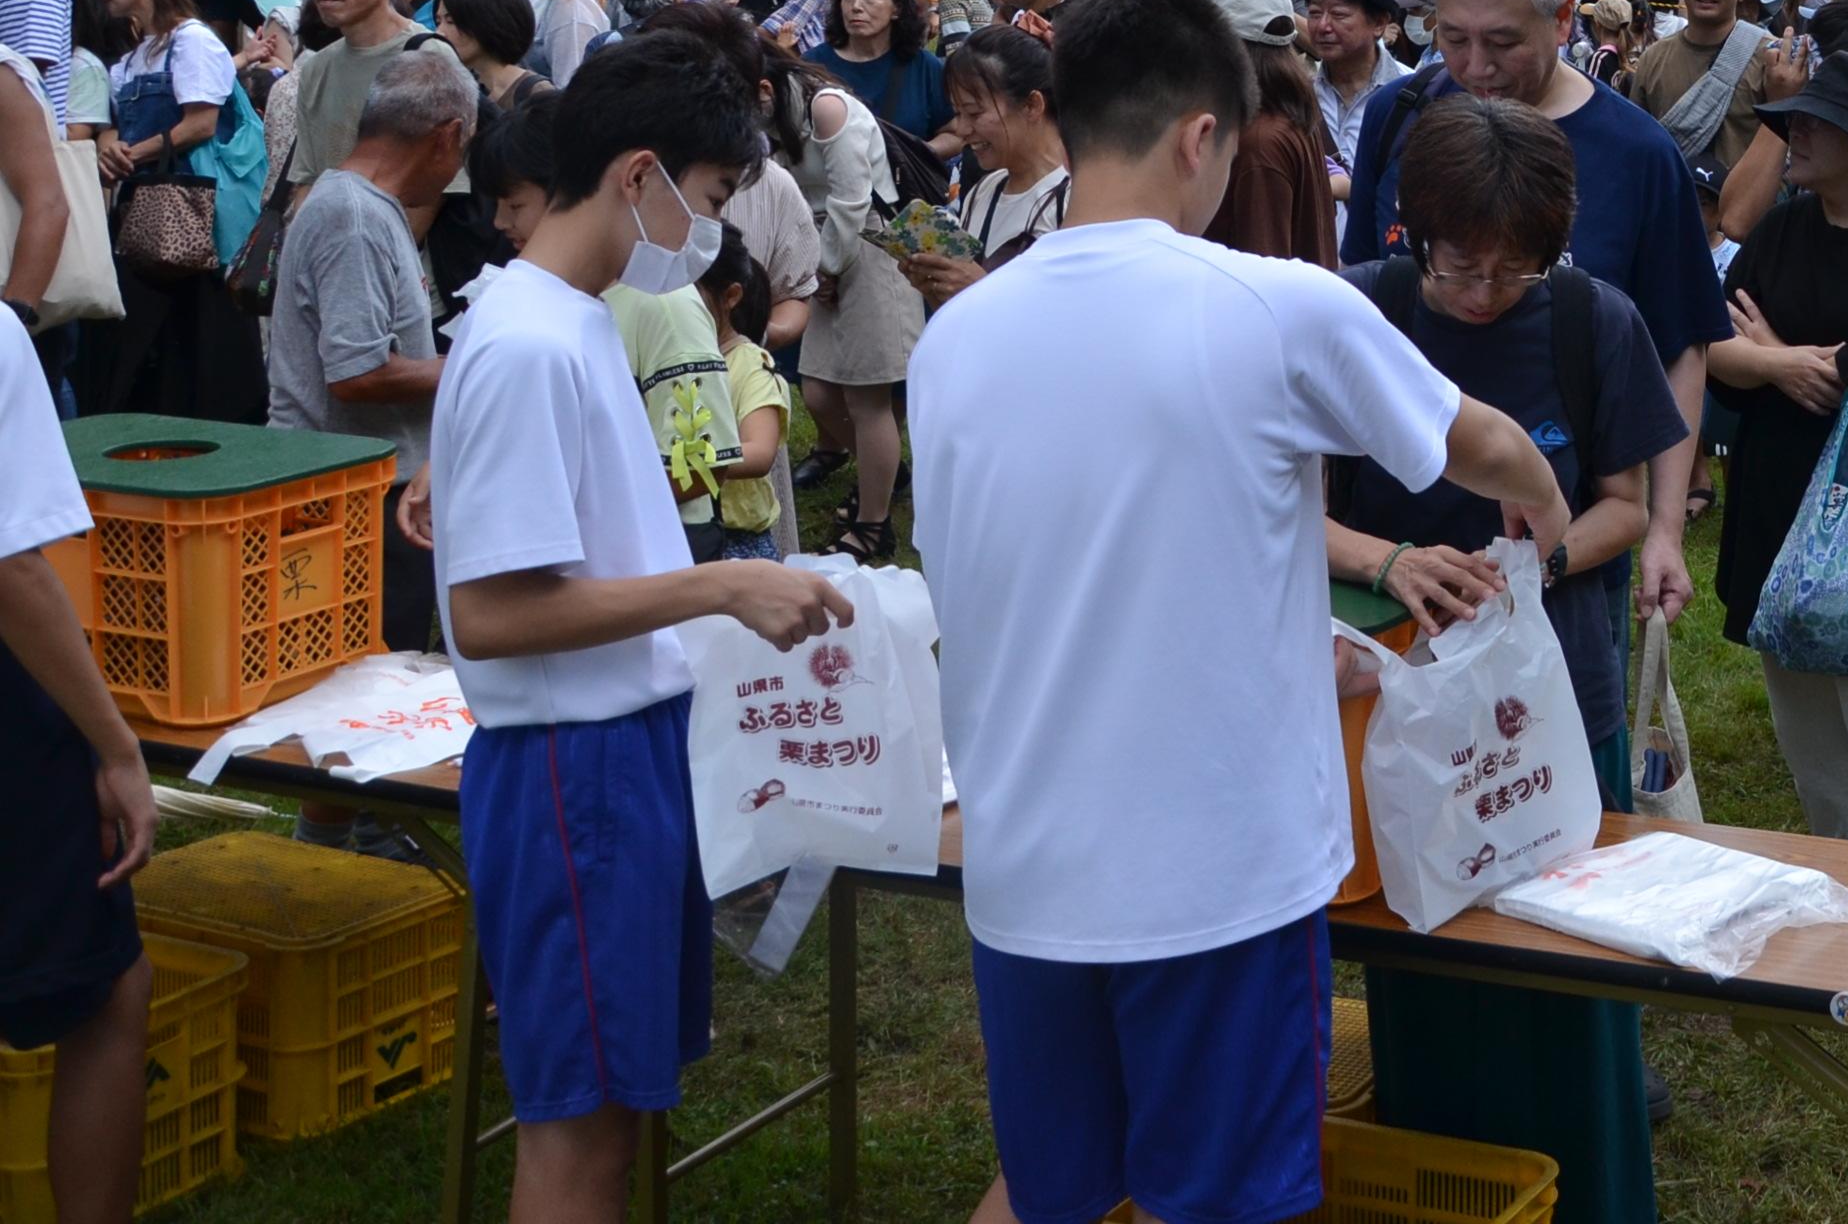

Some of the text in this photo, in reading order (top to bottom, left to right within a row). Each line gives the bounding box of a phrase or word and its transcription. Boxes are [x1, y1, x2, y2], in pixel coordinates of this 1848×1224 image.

[736, 676, 784, 698] 山県市
[738, 696, 844, 733] ふるさと
[778, 734, 881, 769] 栗まつり
[1475, 765, 1552, 824] 栗まつり
